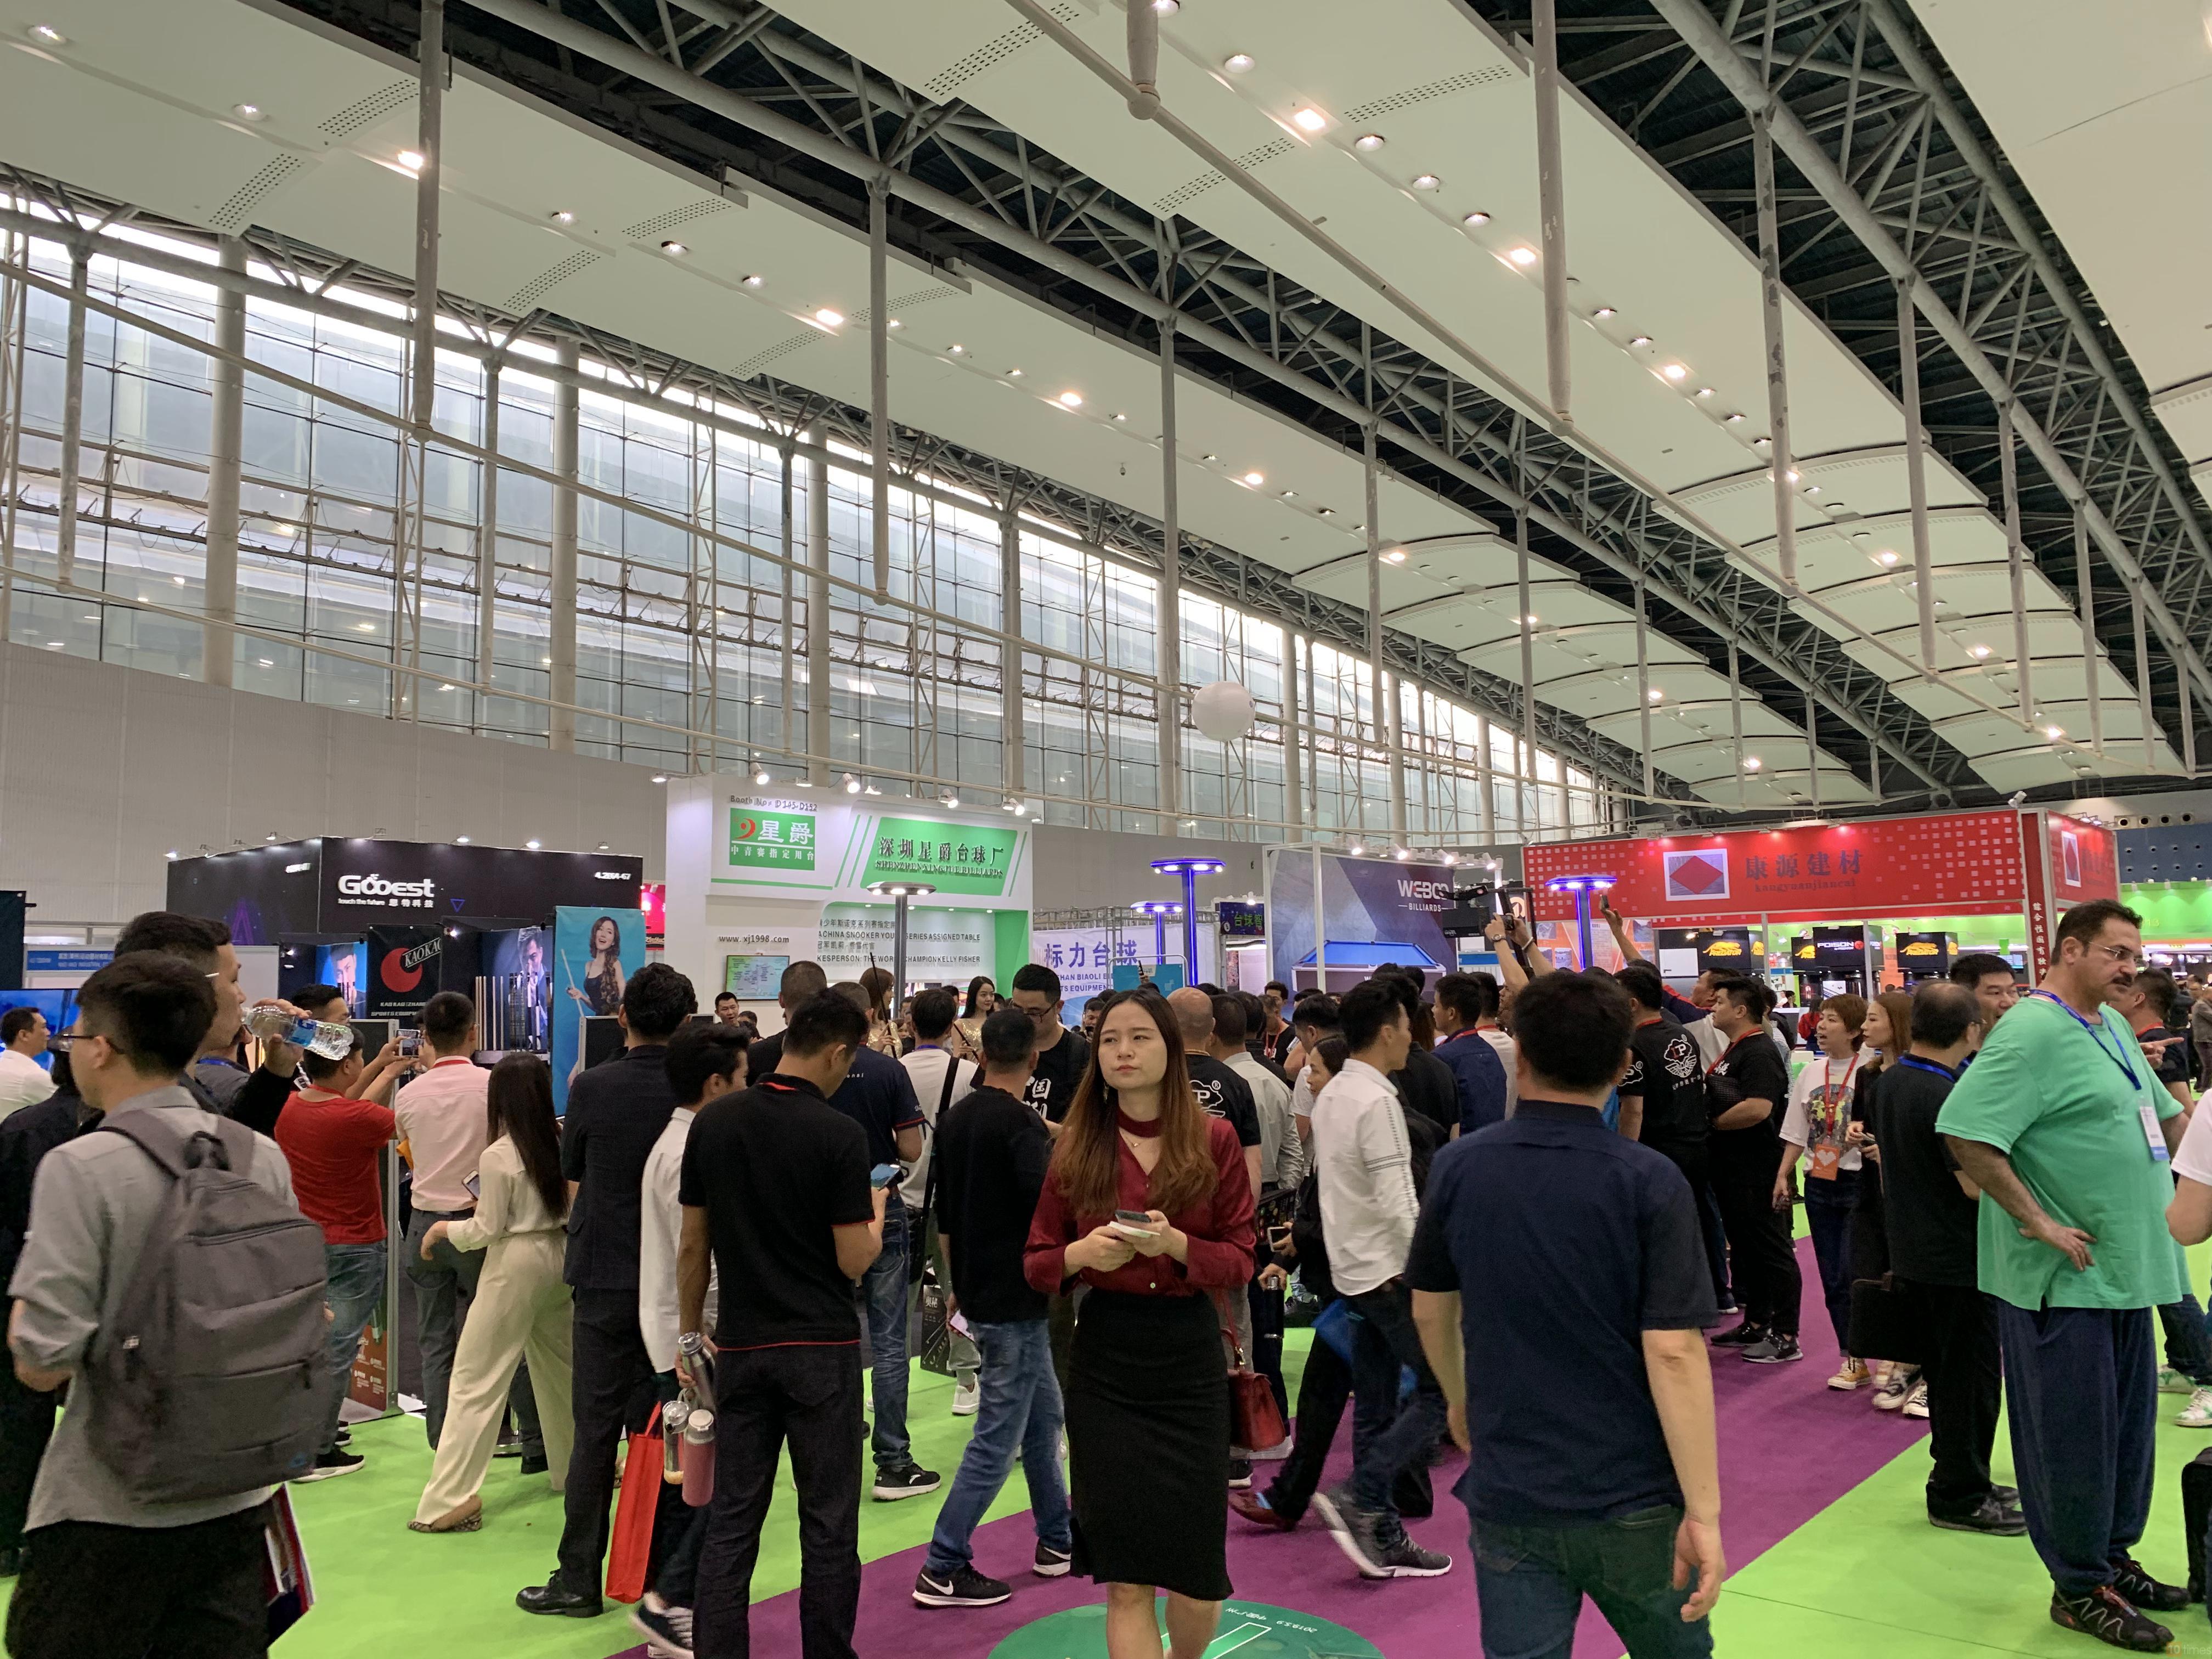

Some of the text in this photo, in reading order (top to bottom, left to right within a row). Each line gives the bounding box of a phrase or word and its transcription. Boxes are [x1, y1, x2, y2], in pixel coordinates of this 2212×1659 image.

[731, 795, 753, 804] Booth
[758, 820, 814, 845] 星爵
[731, 845, 814, 861] 中青赛指定用台
[879, 836, 1004, 866] 深圳星爵台球厂
[1746, 849, 1863, 880] 康源建材
[1409, 902, 1442, 912] BILLIARDS
[820, 918, 896, 929] 少年斯诺克系列赛指定用
[1045, 939, 1138, 969] 标力台球
